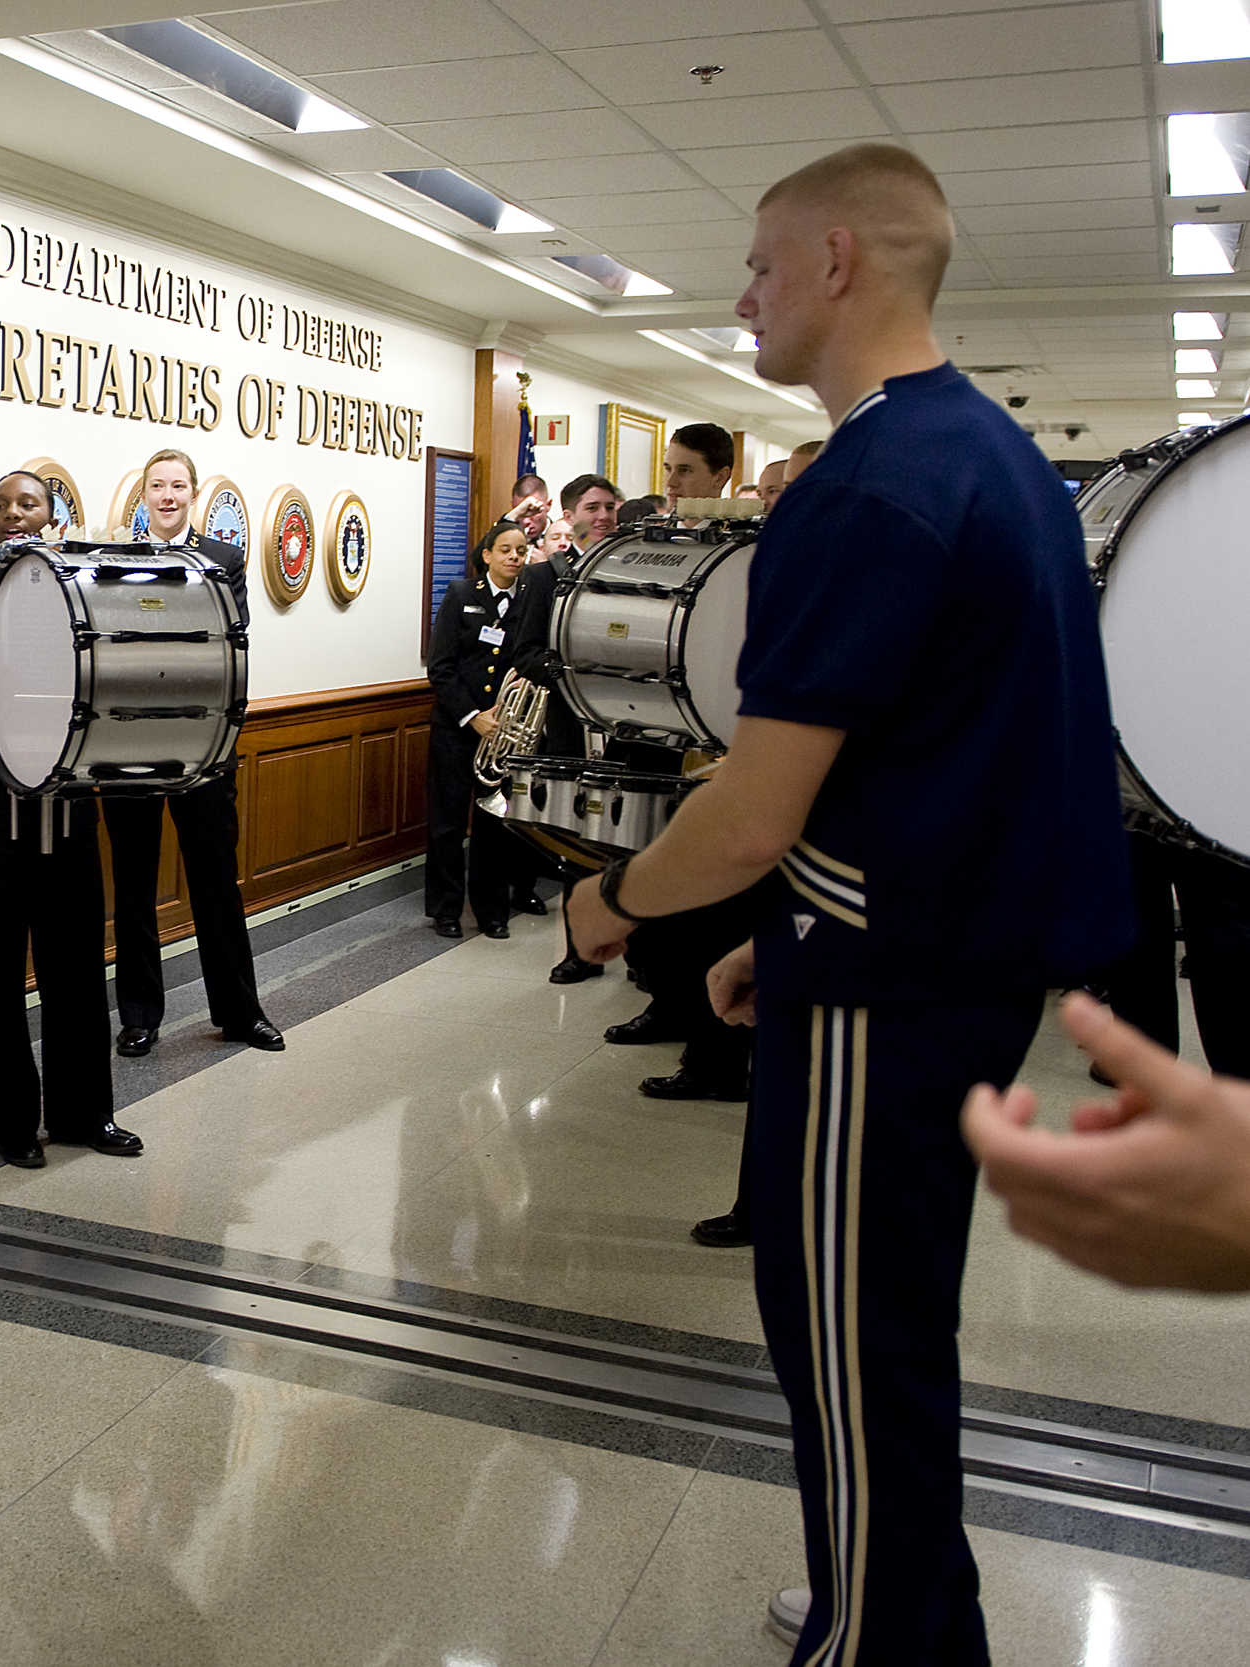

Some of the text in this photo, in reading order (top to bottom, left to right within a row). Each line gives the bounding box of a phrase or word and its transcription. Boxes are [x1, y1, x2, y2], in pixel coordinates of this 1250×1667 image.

[238, 292, 275, 345] OF
[283, 304, 383, 373] DEFENSE
[237, 373, 286, 441] OF
[297, 385, 424, 462] DEFENSE
[105, 556, 164, 564] YAMAHA
[634, 552, 688, 567] YAMAHA
